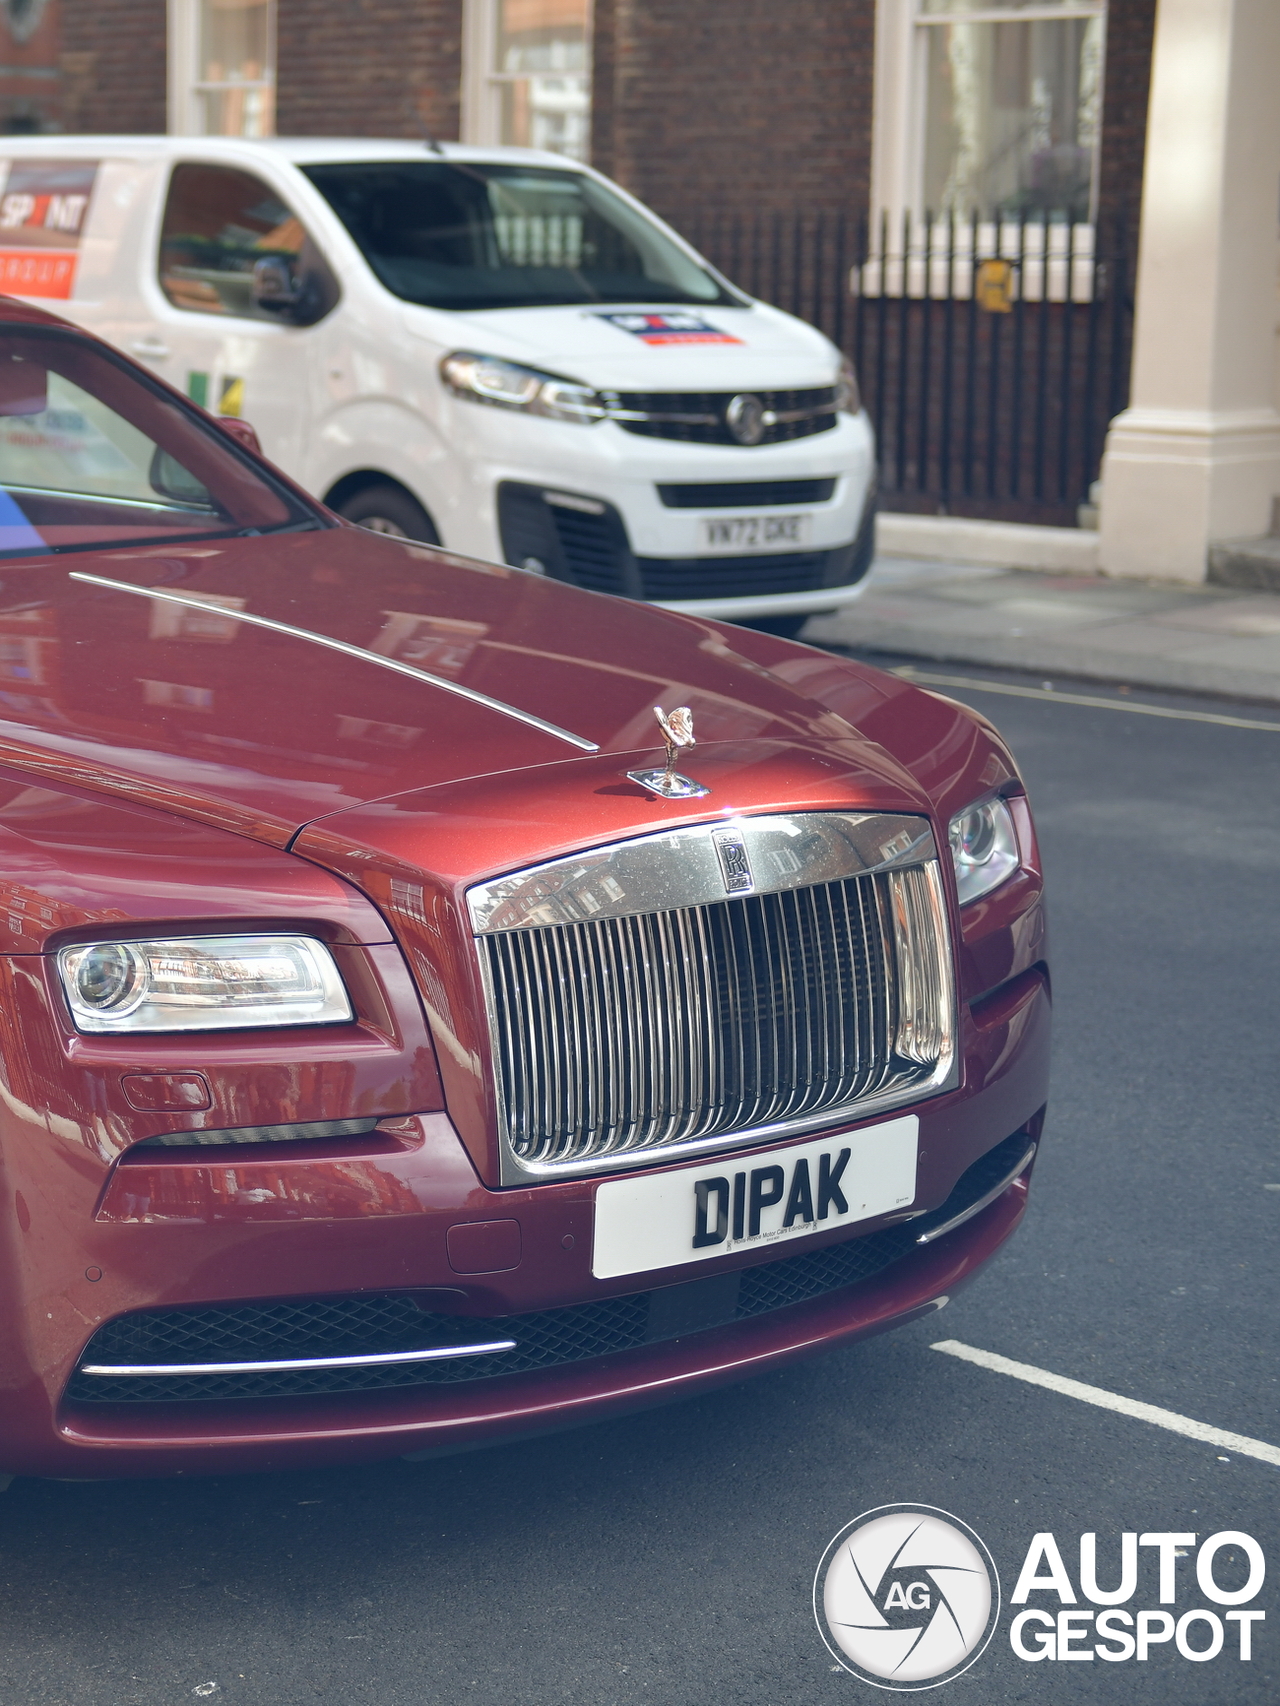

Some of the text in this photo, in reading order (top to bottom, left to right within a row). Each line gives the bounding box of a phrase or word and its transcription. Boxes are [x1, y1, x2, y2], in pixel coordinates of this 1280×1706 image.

[692, 1147, 852, 1249] DIPAK
[762, 1231, 776, 1239] Motor
[788, 1222, 812, 1233] Edinburgh
